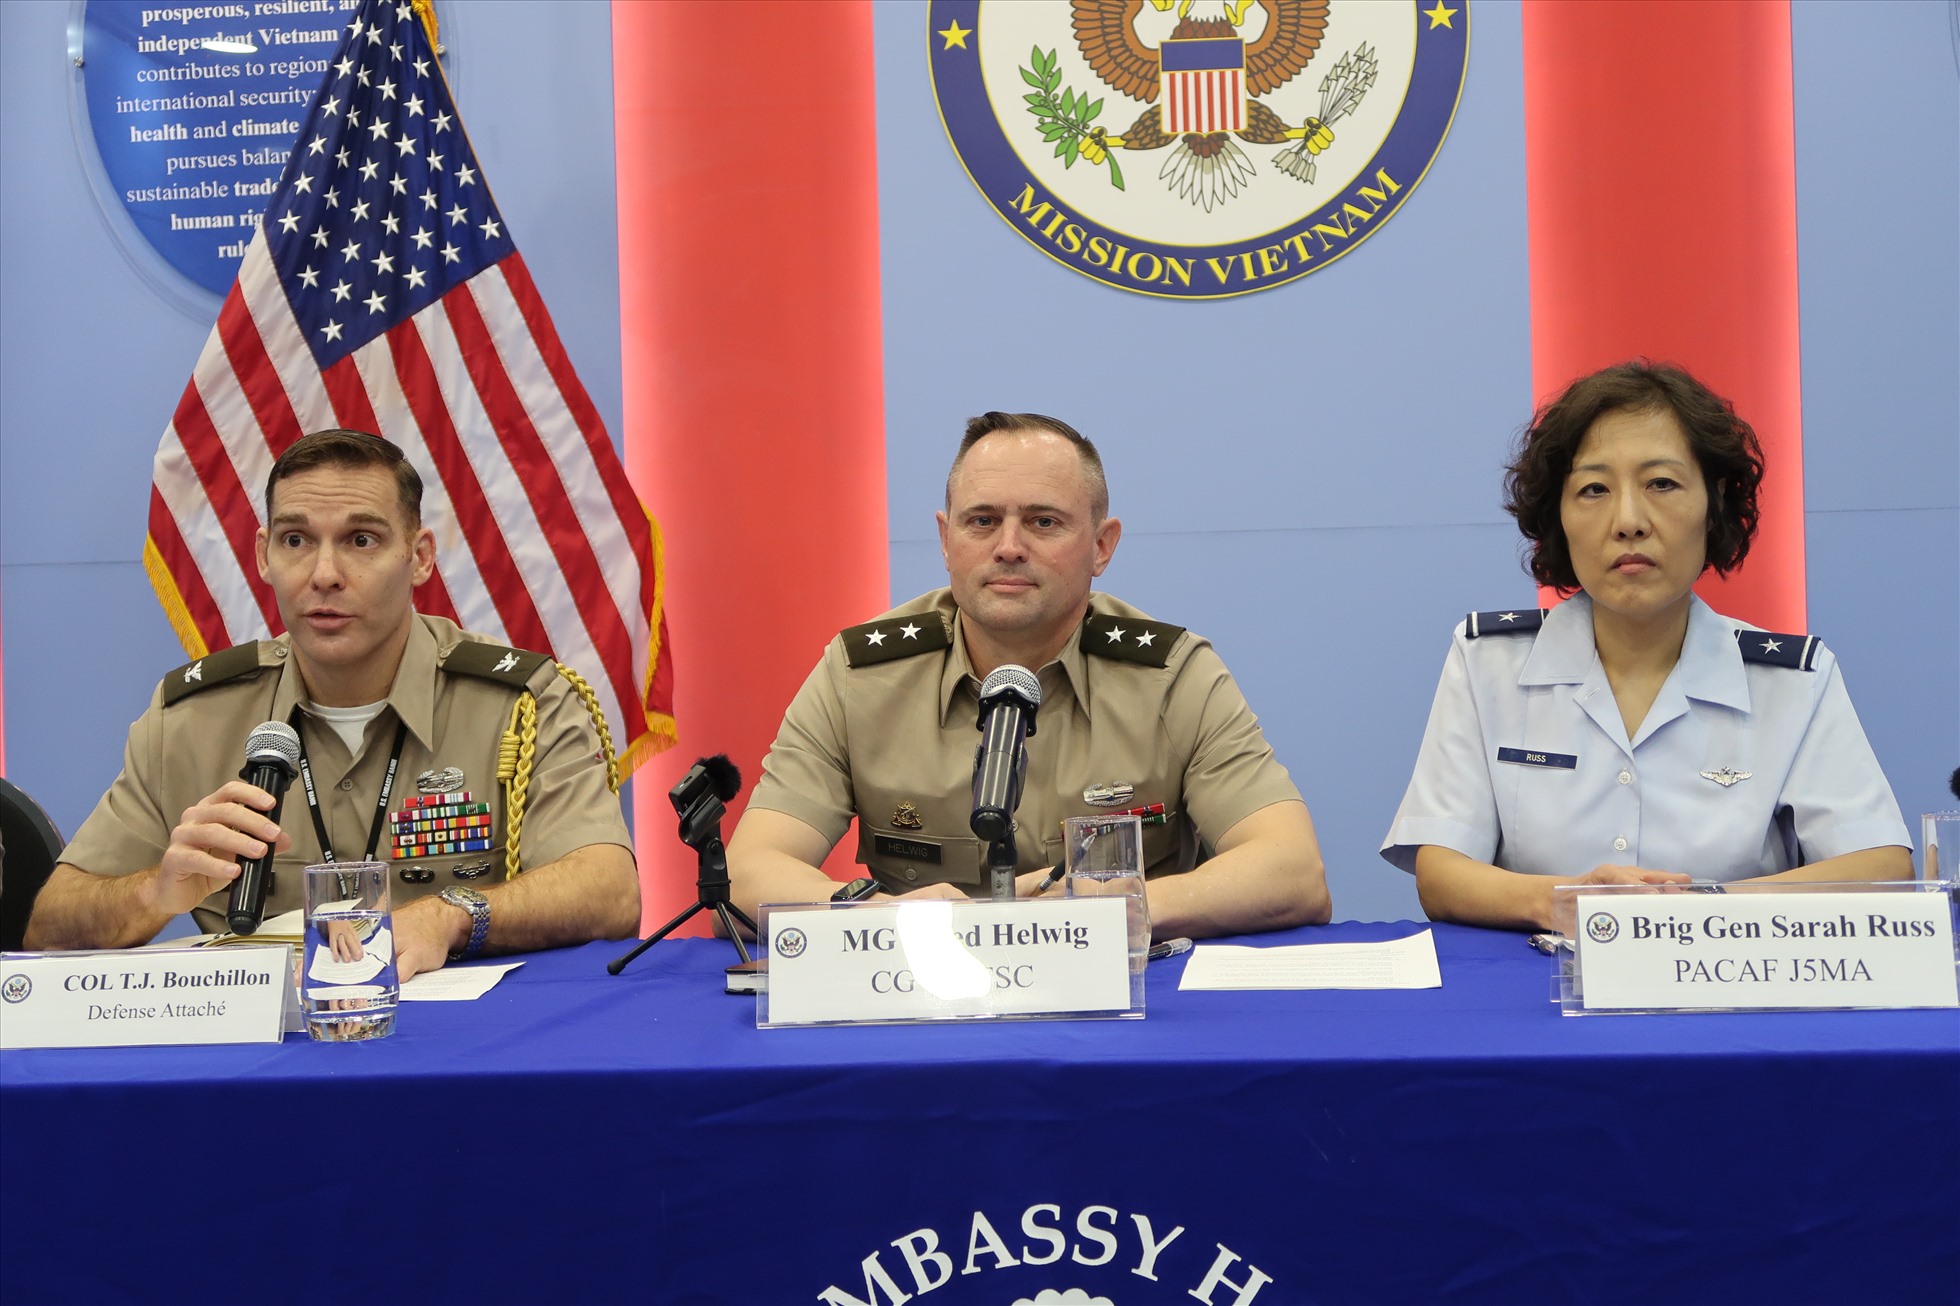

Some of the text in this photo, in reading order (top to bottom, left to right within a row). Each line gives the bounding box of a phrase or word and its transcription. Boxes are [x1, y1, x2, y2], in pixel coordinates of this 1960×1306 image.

[142, 4, 249, 26] prosperous,
[258, 27, 339, 46] Vietnam
[137, 56, 331, 83] contributes to region
[116, 89, 235, 113] international
[130, 117, 299, 143] health and climate
[166, 153, 237, 174] pursues
[126, 181, 228, 202] sustainable
[171, 212, 235, 231] human
[1009, 168, 1402, 287] MISSION VIETNAM
[218, 240, 249, 258] rul
[1526, 754, 1546, 763] RUSS
[888, 842, 928, 857] HELWIG
[842, 927, 896, 953] MG
[992, 921, 1089, 949] Helwig
[1631, 914, 1936, 945] Brig Gen Sarah Russ
[64, 969, 271, 993] COL T.J. Bouchillon
[871, 964, 1034, 994] CG SC
[1674, 958, 1873, 983] PACAF J5MA
[88, 1001, 226, 1021] Defense Attaché
